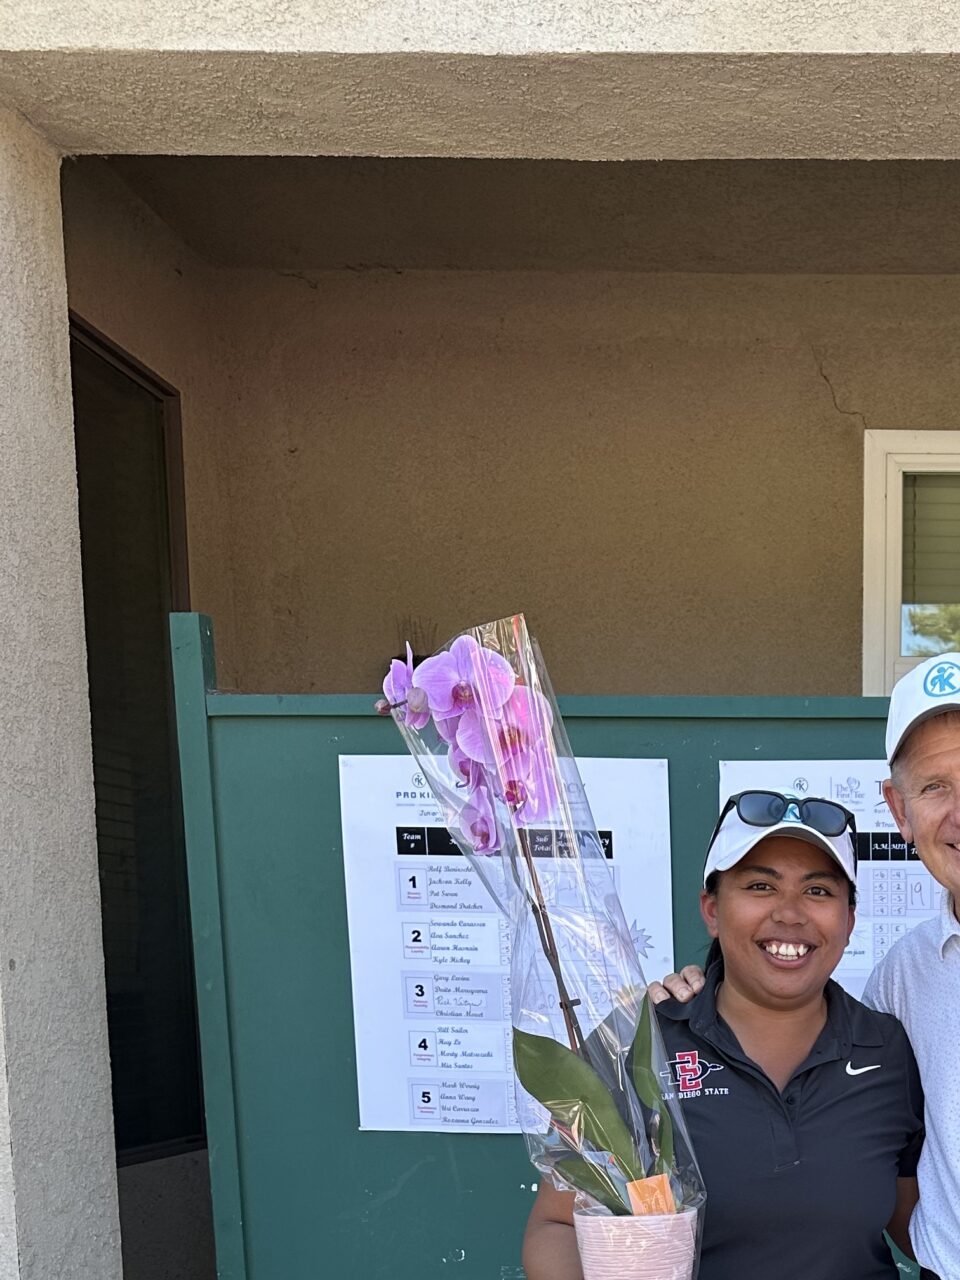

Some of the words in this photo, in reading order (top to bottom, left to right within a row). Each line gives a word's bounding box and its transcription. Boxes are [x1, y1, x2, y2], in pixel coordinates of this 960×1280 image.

[408, 876, 417, 889] 1
[411, 929, 422, 943] 2
[414, 984, 425, 997] 3
[418, 1038, 428, 1051] 4
[421, 1091, 431, 1104] 5
[678, 1091, 701, 1099] DIEGO
